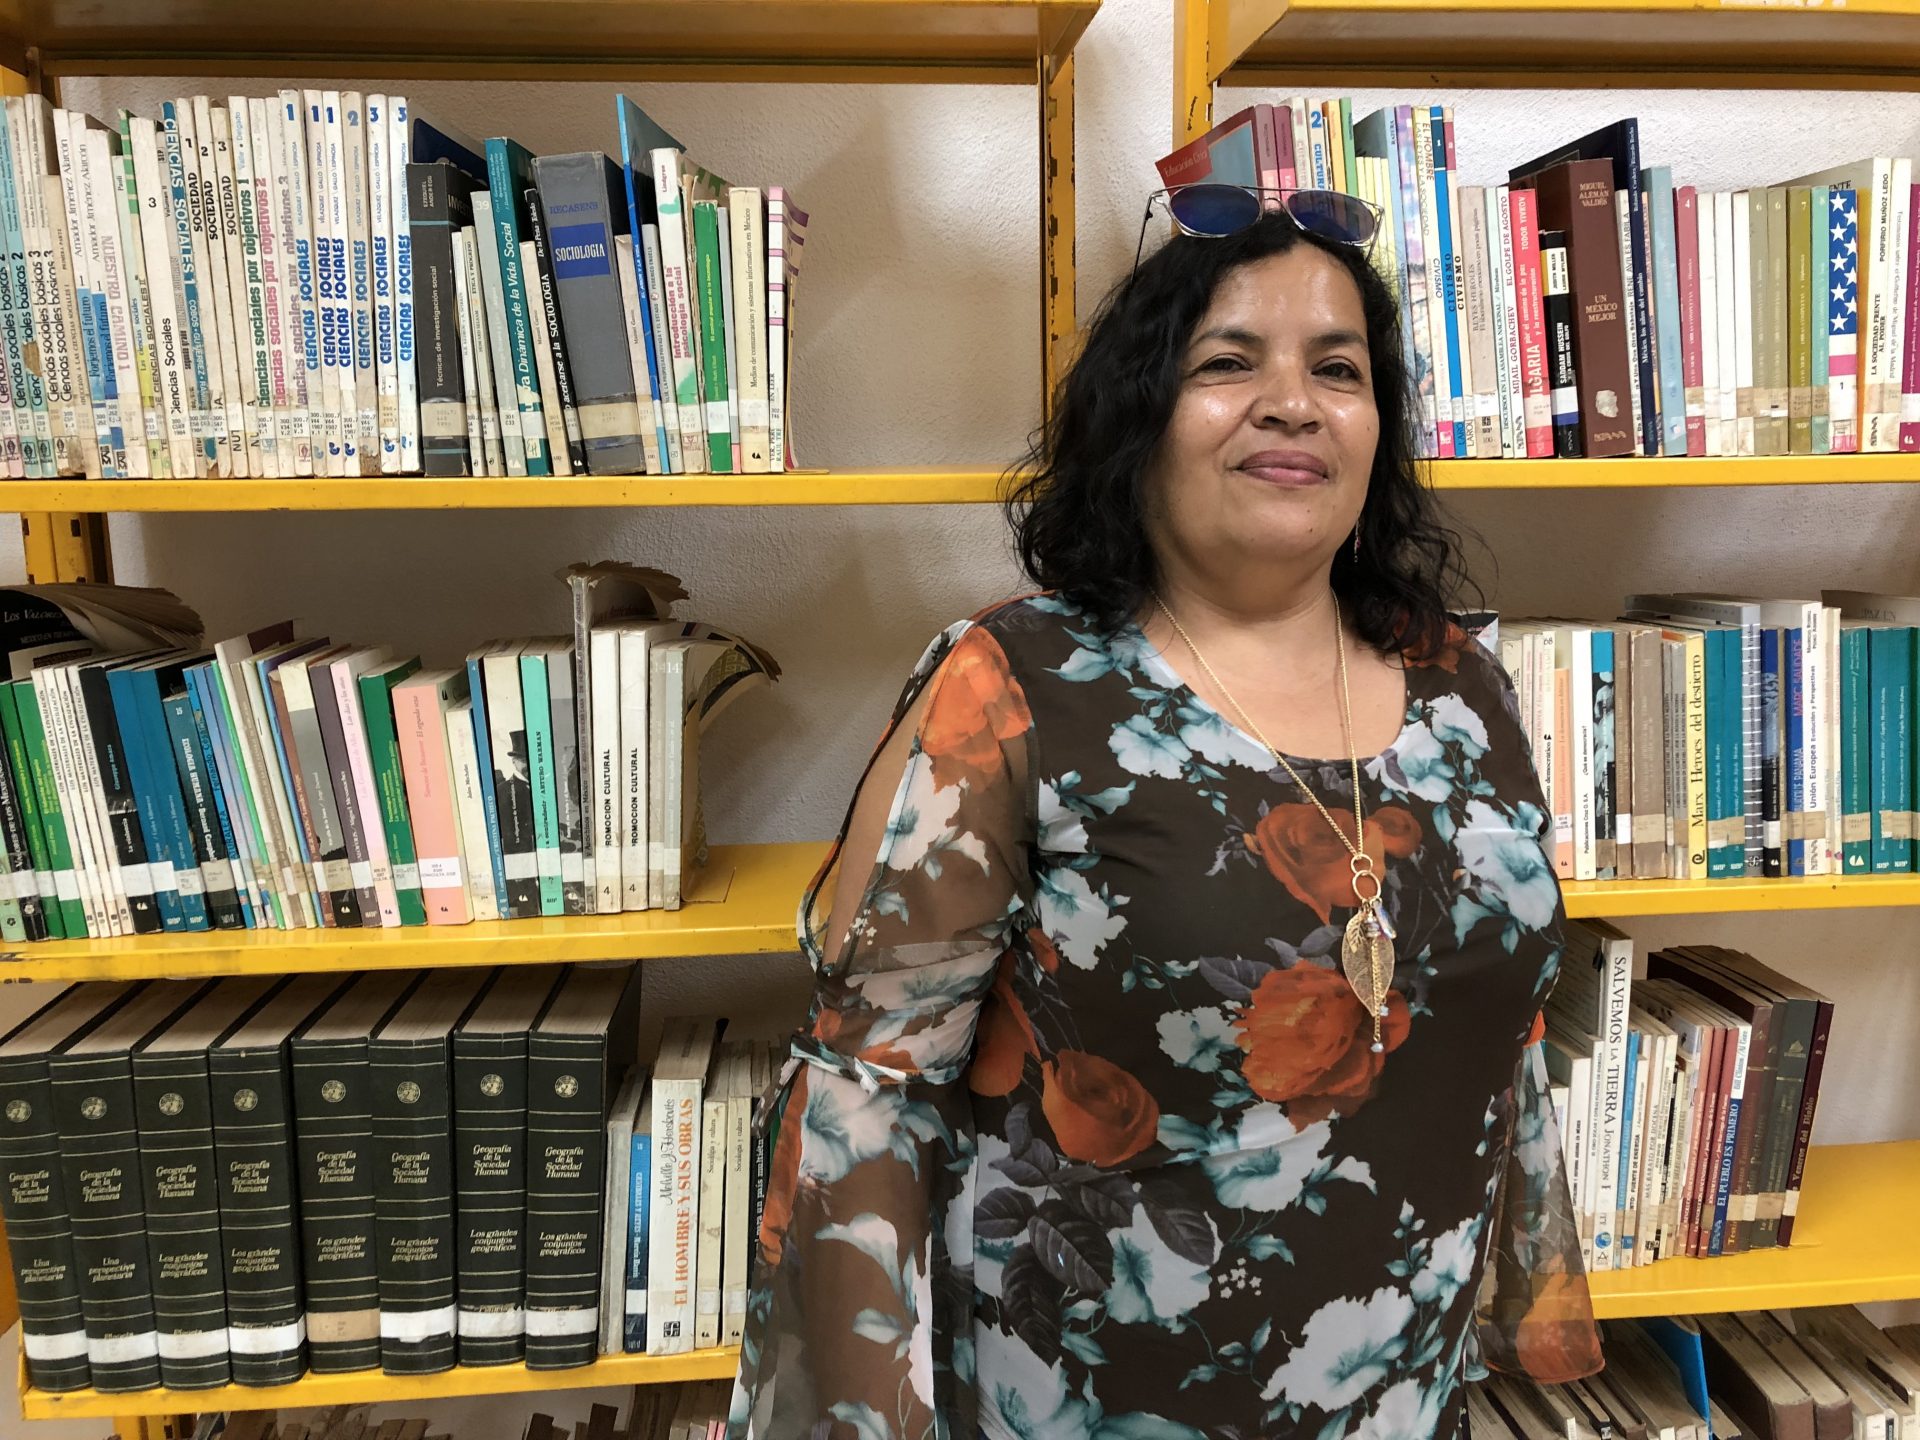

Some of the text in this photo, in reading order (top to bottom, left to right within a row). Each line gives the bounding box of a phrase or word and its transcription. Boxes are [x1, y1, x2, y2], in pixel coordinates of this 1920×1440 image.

[287, 104, 294, 120] 1
[312, 106, 319, 122] 1
[326, 107, 334, 123] 1
[348, 111, 358, 126] 2
[370, 107, 379, 122] 3
[398, 107, 407, 122] 3
[1311, 111, 1326, 190] 2 CULTUR
[1423, 123, 1434, 181] EL HOMBRE
[164, 118, 184, 189] CIENCIAS
[174, 198, 195, 274] SOCIALES
[185, 138, 203, 232] SOCIEDAD 1
[200, 146, 218, 240] SOCIEDAD 2
[217, 141, 237, 235] SOCIEDAD 3
[255, 177, 266, 186] 2
[1579, 181, 1606, 190] MIGUEL
[148, 197, 157, 208] 3
[549, 201, 599, 215] RECASENS
[743, 208, 752, 231] México
[1880, 197, 1888, 224] MUÑOZ
[69, 219, 82, 257] Amador
[239, 189, 258, 255] objetivos
[257, 189, 275, 255] objetivos
[501, 222, 515, 257] Social
[1521, 225, 1529, 250] TODOR
[29, 250, 41, 259] 3
[555, 243, 606, 262] SOCIOLOGIA
[247, 259, 262, 283] por
[265, 259, 278, 283] por
[507, 262, 519, 288] Vida
[665, 267, 673, 277] la
[674, 266, 685, 299] social
[1443, 253, 1456, 312] CIVISMO
[1454, 255, 1465, 310] CIVISMO
[103, 236, 129, 360] NUESTRO CAMINO
[296, 239, 318, 370] CIENCIAS SOCIALES
[317, 237, 337, 367] CIENCIAS SOCIALES
[332, 238, 352, 367] CIENCIAS SOCIALES
[354, 240, 371, 369] CIENCIAS SOCIALES
[374, 236, 392, 364] CIENCIAS SOCIALES
[398, 235, 412, 361] CIENCIAS SOCIALES
[510, 287, 519, 299] la
[512, 301, 523, 318] de
[541, 274, 559, 337] SOCIOLOGIA
[746, 281, 754, 307] sistemas
[1500, 196, 1520, 394] MIJAIL GORBACHEV EL GOLPE DE AGOSTO
[1594, 294, 1608, 303] UN
[1873, 293, 1881, 323] FRENTE
[37, 307, 53, 356] sociales
[250, 286, 265, 346] sociales
[265, 286, 281, 345] sociales
[430, 265, 443, 387] Técnicas de investigación social
[668, 291, 682, 359] Introducción
[1588, 313, 1617, 323] MEJOR
[4, 311, 20, 359] sociales
[162, 318, 175, 366] Sociales
[516, 320, 529, 373] Dinámica
[747, 313, 757, 356] comunicación
[1557, 322, 1567, 384] SADDAM HUSSEIN
[1871, 365, 1877, 375] LA
[10, 356, 27, 408] Ciencias
[43, 351, 59, 402] Ciencias
[749, 366, 758, 388] Medios
[1689, 654, 1702, 709] destierro
[1689, 713, 1702, 732] del
[630, 747, 638, 793] CULTURAL
[1809, 744, 1818, 779] Europea
[1691, 793, 1704, 827] Marx
[1809, 782, 1817, 808] Unión
[604, 798, 612, 848] ROMOCION
[603, 886, 611, 895] 4
[629, 883, 636, 893] 4
[1601, 957, 1627, 1181] SALVEMOS LA TIERRA JONATHON
[473, 1144, 512, 1156] Geografía
[473, 1160, 511, 1169] Sociedad
[483, 1153, 492, 1161] de
[1717, 1103, 1739, 1207] EL PUEBLO ES PRIMERO
[474, 1168, 508, 1176] Humana
[674, 1097, 694, 1306] EL HOMBRE Y SUS OBRAS
[470, 1229, 518, 1239] Los grandes
[474, 1237, 513, 1247] conjuntos
